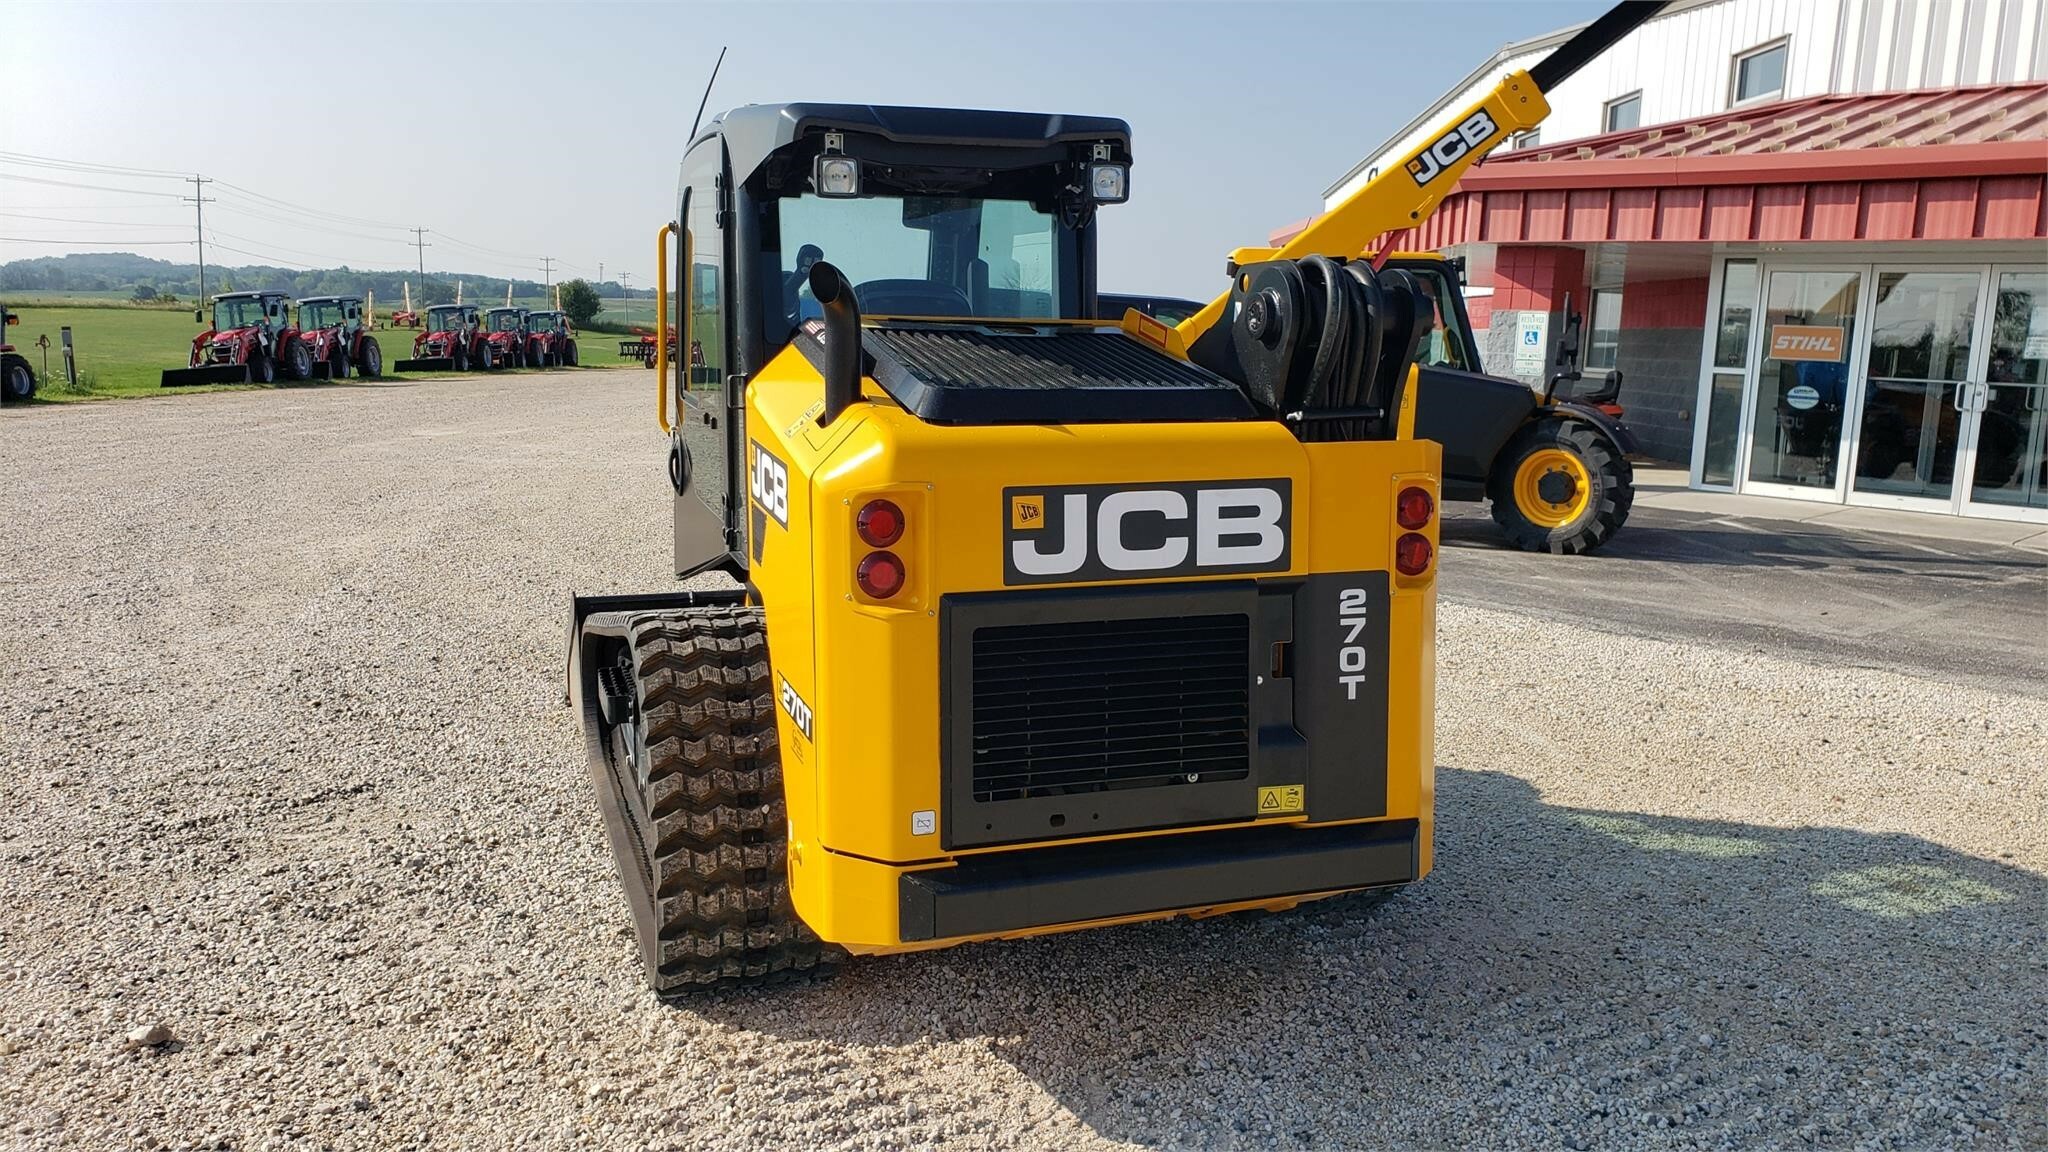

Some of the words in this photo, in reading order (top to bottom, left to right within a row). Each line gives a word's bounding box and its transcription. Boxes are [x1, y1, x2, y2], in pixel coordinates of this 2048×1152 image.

[1414, 112, 1496, 183] JCB
[1774, 335, 1835, 352] STIHL
[751, 447, 788, 523] JCB
[1020, 504, 1039, 520] JCB
[1012, 488, 1284, 575] JCB
[1339, 588, 1366, 700] 270T
[782, 679, 812, 738] 270T
